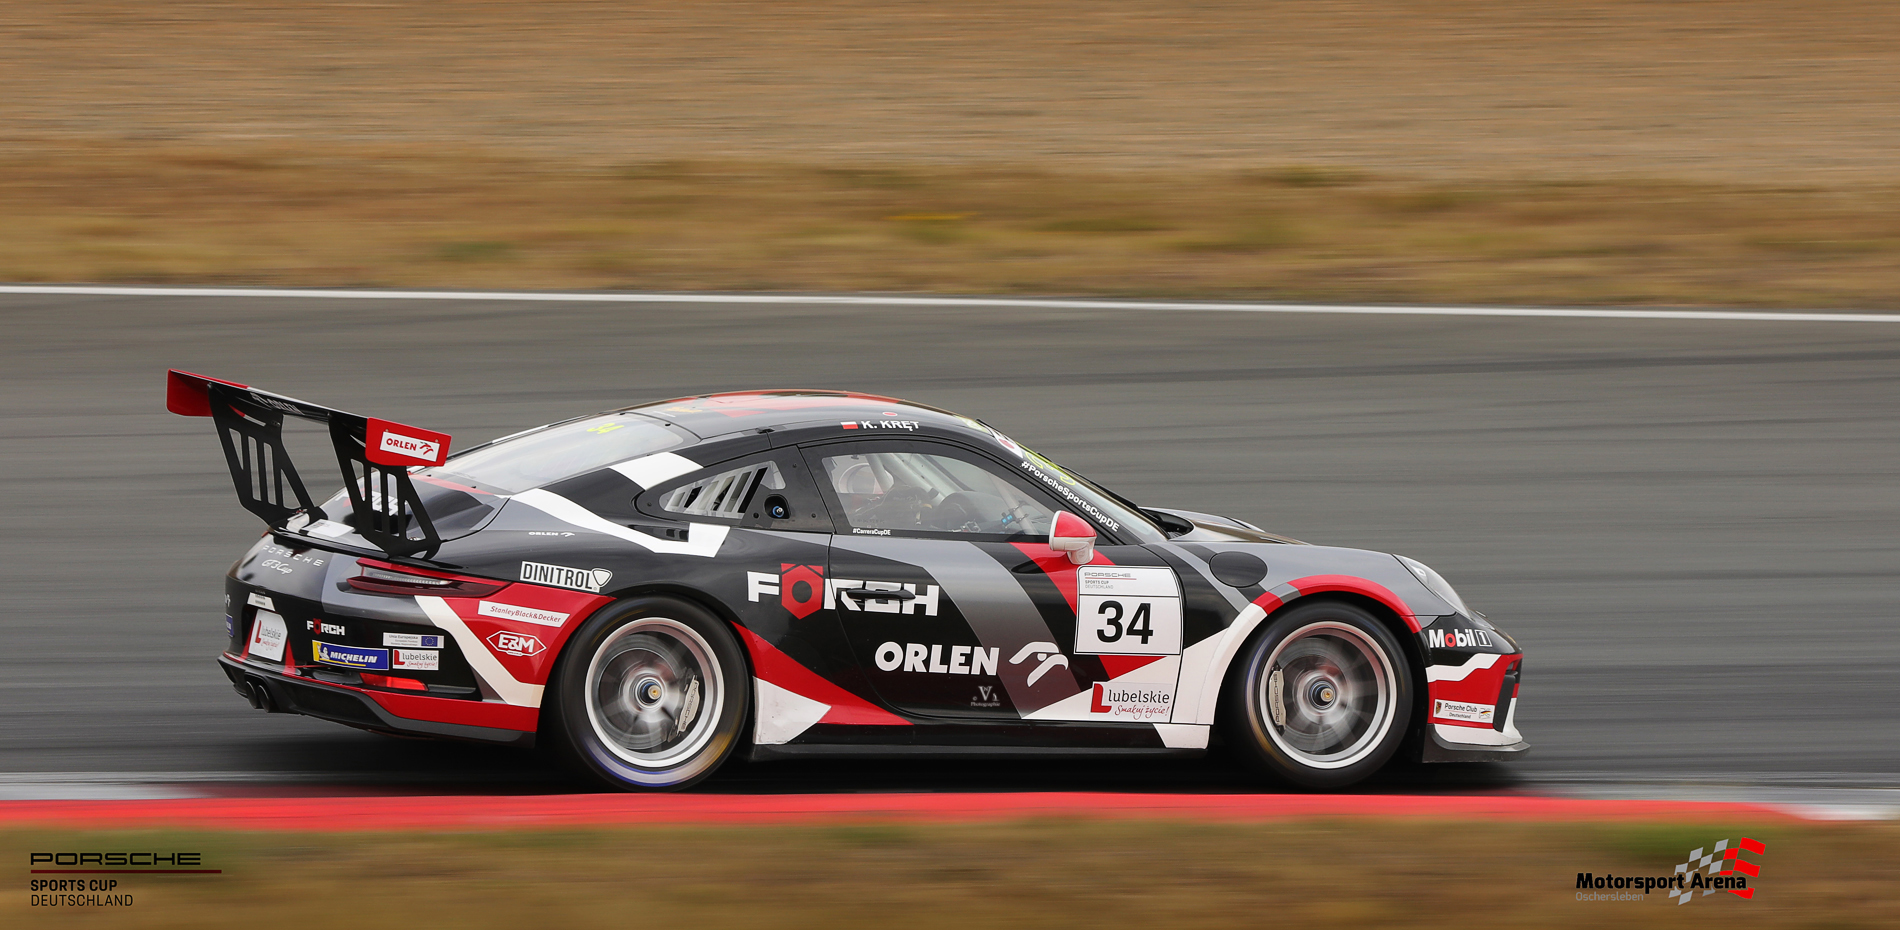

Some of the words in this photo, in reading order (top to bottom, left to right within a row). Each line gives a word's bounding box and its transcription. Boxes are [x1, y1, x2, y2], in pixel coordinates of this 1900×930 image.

[860, 420, 878, 429] K.
[880, 420, 920, 432] KRĘT
[386, 438, 417, 451] ORLEN
[1020, 461, 1120, 533] #PorscheSportsCupDE
[852, 528, 892, 536] #CarreraCupDE
[262, 545, 325, 566] PORSCHE
[523, 563, 592, 589] DINITROL
[490, 605, 562, 623] StanleyBlack&Decker
[1096, 600, 1154, 645] 34
[497, 633, 535, 653] E&M
[1428, 628, 1476, 648] Mobil
[330, 651, 378, 664] MICHELIN
[402, 652, 438, 661] lubelskie
[875, 641, 1000, 676] ORLEN
[1108, 689, 1170, 704] lubelskie
[681, 681, 698, 731] PORSCHE
[1114, 704, 1146, 720] Smakuj
[1144, 705, 1170, 719] życie!
[1444, 703, 1466, 712] Porsche
[1465, 705, 1478, 713] Club
